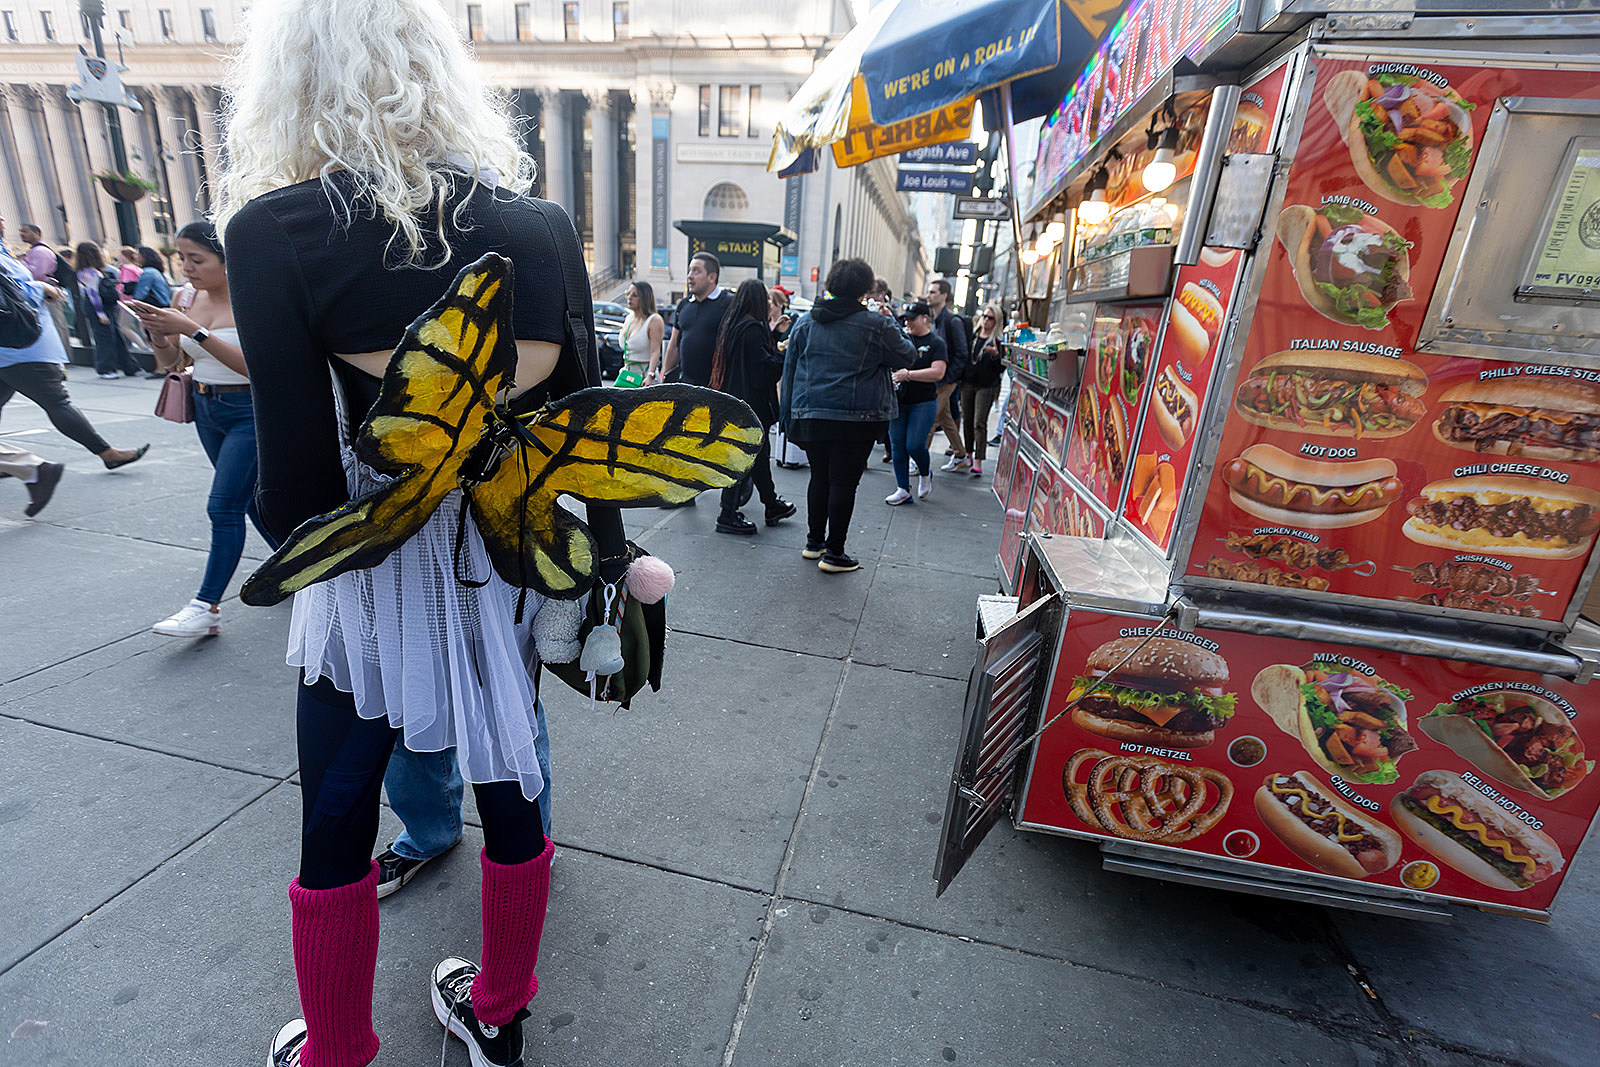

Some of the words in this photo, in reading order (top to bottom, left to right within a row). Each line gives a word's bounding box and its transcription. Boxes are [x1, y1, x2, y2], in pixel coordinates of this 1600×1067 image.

[884, 68, 930, 99] WE'RE
[934, 57, 955, 80] ON
[960, 53, 969, 71] A
[974, 36, 1013, 66] ROLL
[1368, 63, 1419, 76] CHICKEN
[1419, 68, 1449, 89] GYRO
[945, 145, 969, 160] Ave
[903, 174, 920, 188] Joe
[922, 174, 949, 189] Louis
[1321, 195, 1351, 205] LAMB
[1351, 198, 1379, 216] GYRO
[729, 243, 752, 254] TAXI
[1290, 338, 1340, 351] ITALIAN
[1341, 340, 1403, 360] SAUSAGE
[1480, 366, 1524, 381] PHILLY
[1525, 365, 1573, 376] CHEESE
[1300, 442, 1328, 457] HOT
[1328, 447, 1358, 458] DOG
[1453, 463, 1488, 478] CHILI
[1490, 463, 1541, 476] CHEESE
[1540, 467, 1570, 484] DOG
[1253, 527, 1292, 536] CHICKEN
[1291, 529, 1320, 544] KEBAB
[1454, 554, 1484, 563] SHISH
[1483, 556, 1514, 571] KEBAB
[1313, 652, 1341, 662] MIX
[1340, 655, 1377, 677] GYRO
[1452, 681, 1504, 702] CHICKEN
[1505, 682, 1545, 695] KEBAB
[1544, 690, 1561, 704] ON
[1558, 699, 1578, 720] PITA
[1120, 742, 1144, 754] HOT
[1144, 746, 1193, 762] PRETZEL
[1330, 774, 1356, 799] CHILI
[1352, 795, 1381, 812] DOG
[1460, 770, 1501, 801] RELISH
[1496, 796, 1523, 815] HOT
[1517, 810, 1545, 831] DOG
